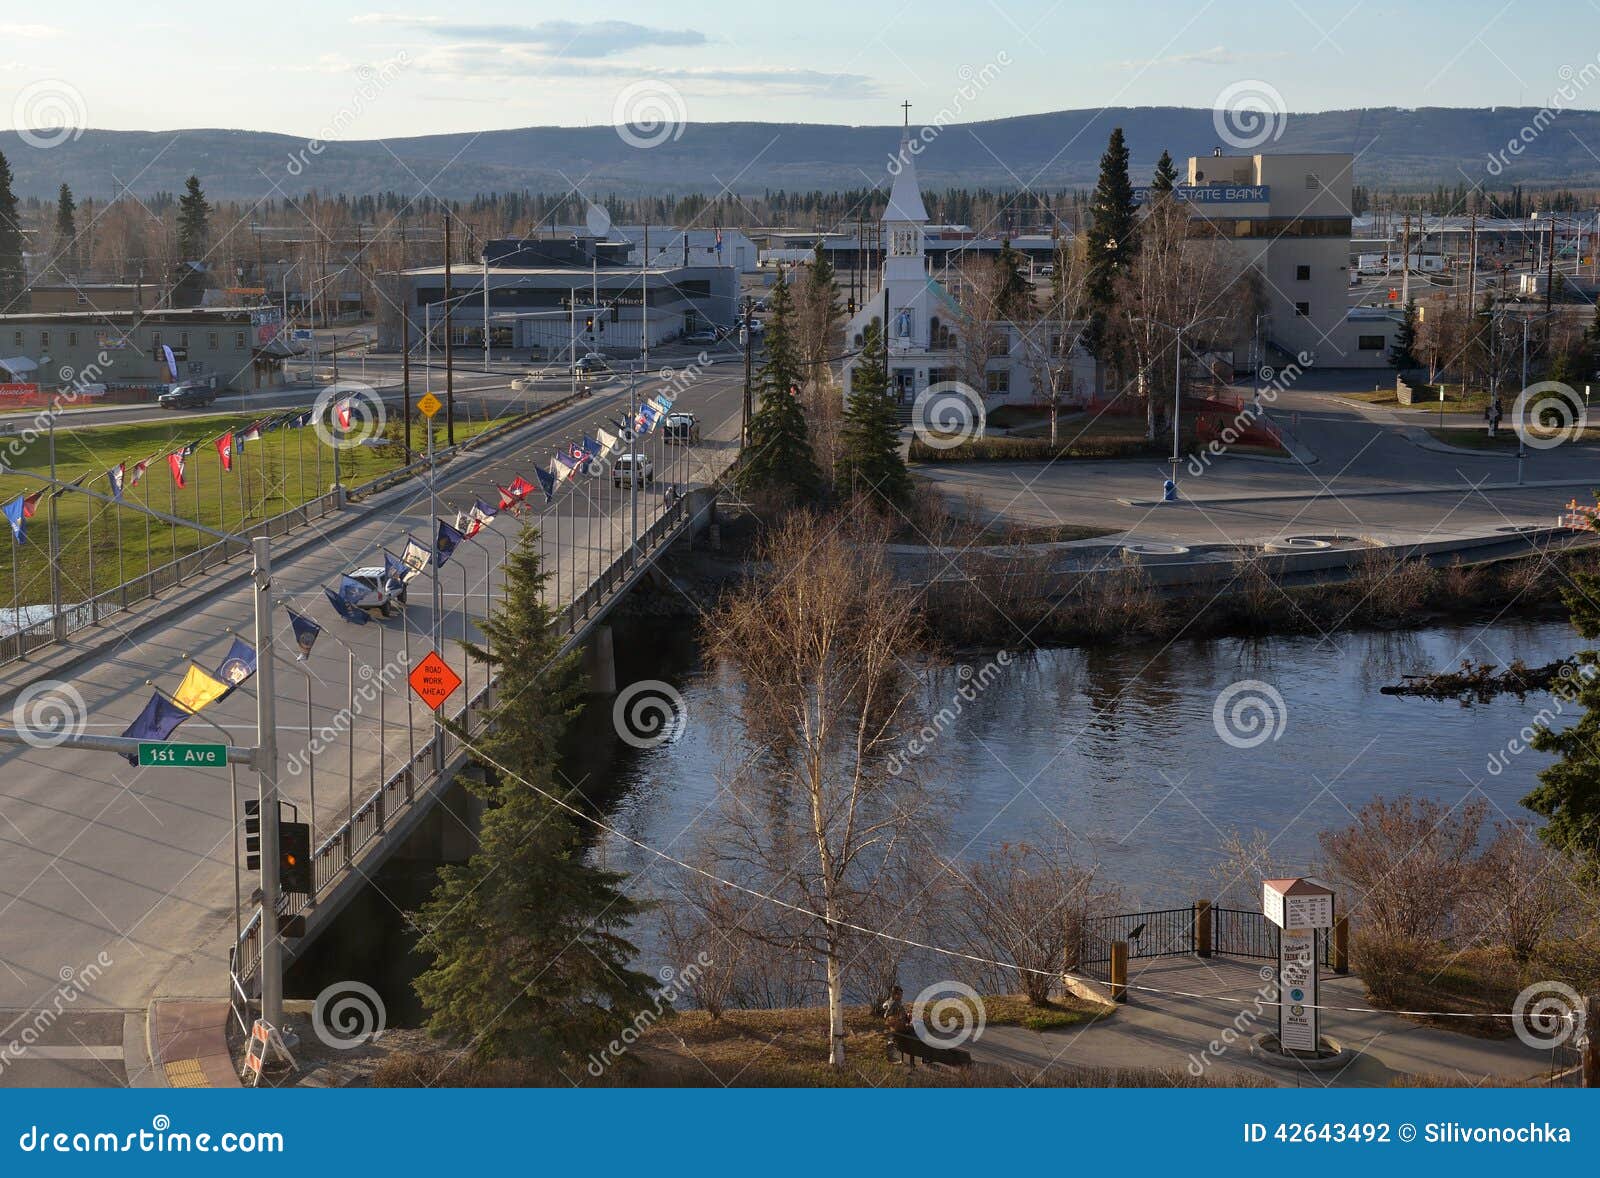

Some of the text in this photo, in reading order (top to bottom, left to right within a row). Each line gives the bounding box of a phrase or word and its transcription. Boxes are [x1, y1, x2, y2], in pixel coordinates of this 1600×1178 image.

[1177, 188, 1264, 200] STATE BANK
[424, 665, 441, 673] ROAD
[423, 677, 443, 685] WORK
[422, 687, 446, 696] AHEAD
[150, 749, 216, 762] 1st Ave
